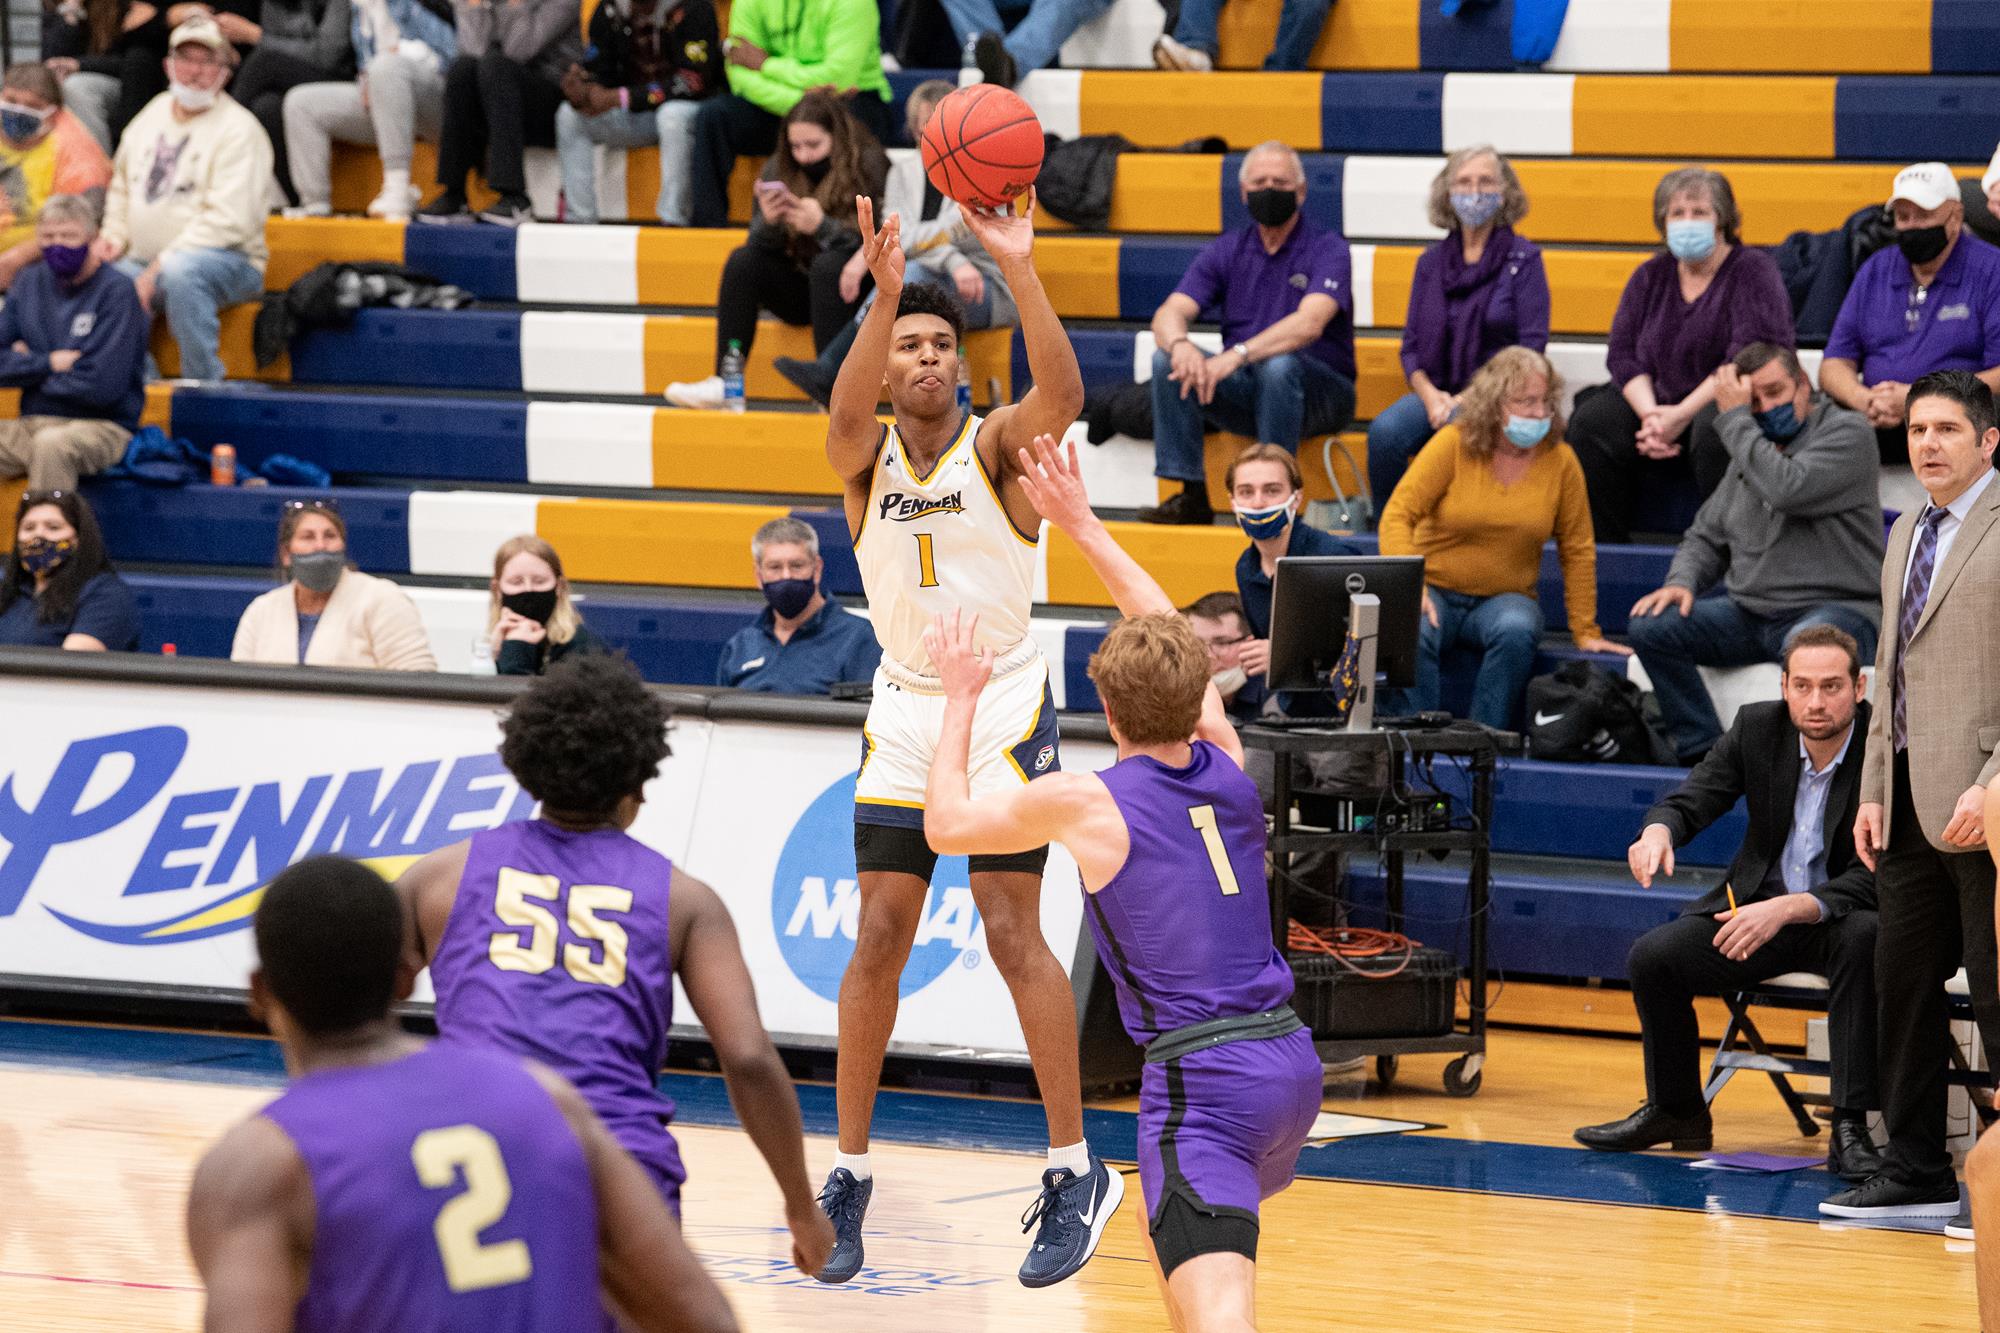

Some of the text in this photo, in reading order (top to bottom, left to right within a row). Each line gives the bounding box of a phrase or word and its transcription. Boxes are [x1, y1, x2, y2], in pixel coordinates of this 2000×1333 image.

[880, 490, 962, 520] PENMEN
[911, 533, 940, 588] 1
[0, 725, 540, 918] PENME
[1187, 803, 1241, 896] 1
[489, 866, 634, 989] 55
[784, 876, 974, 951] NA
[410, 1122, 533, 1293] 2
